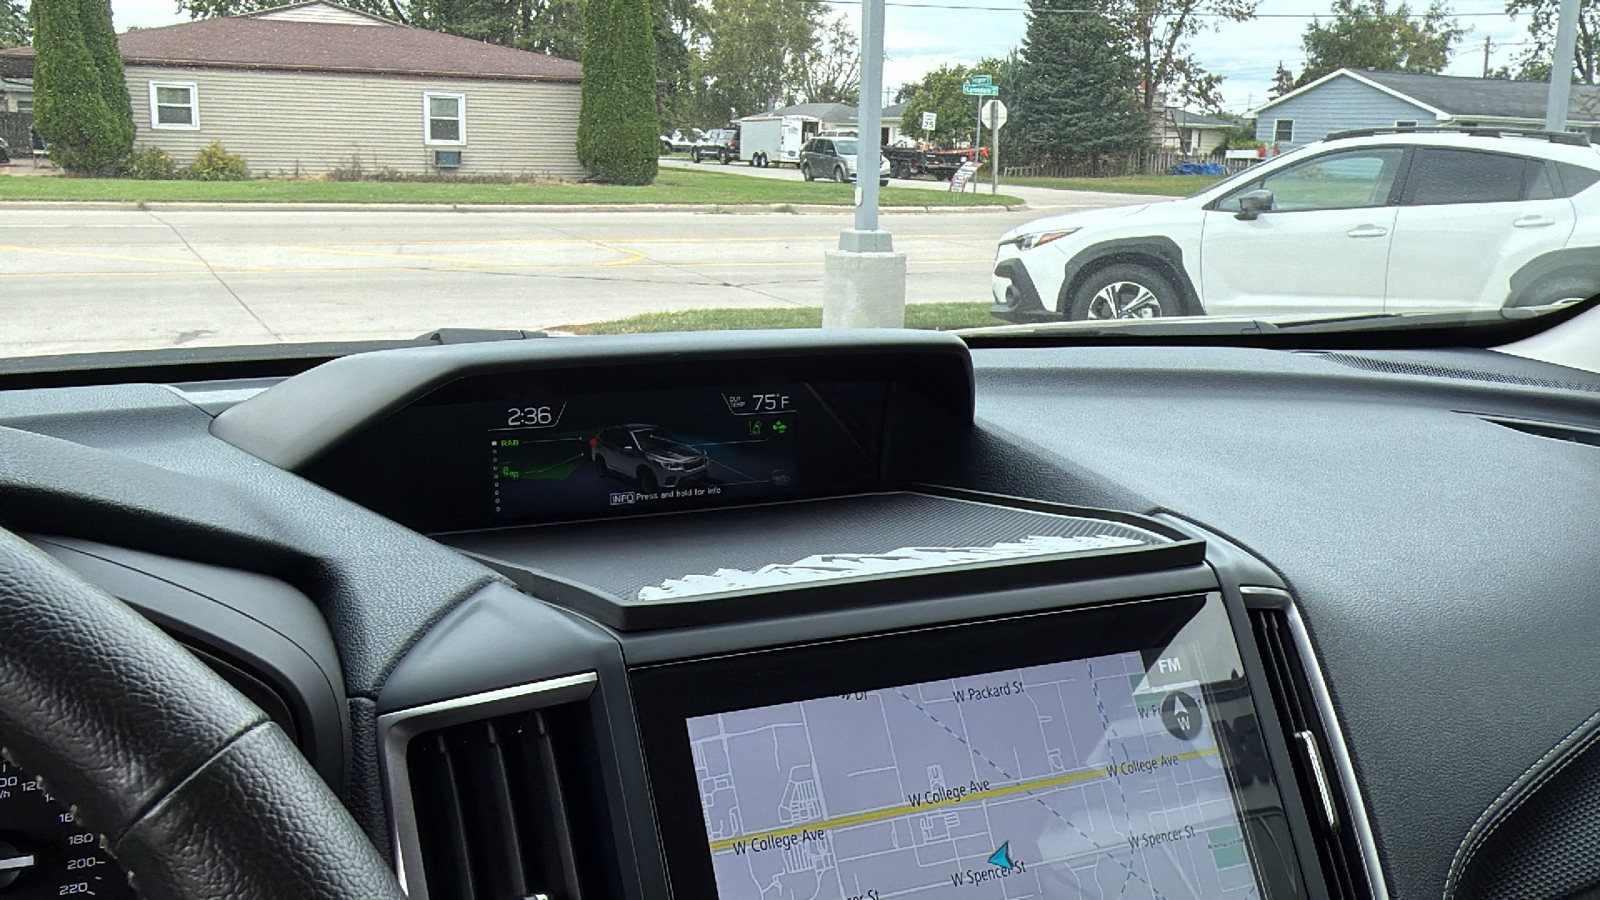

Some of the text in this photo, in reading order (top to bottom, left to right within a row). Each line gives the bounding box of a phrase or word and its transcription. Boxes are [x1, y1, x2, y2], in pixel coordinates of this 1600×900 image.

[508, 406, 552, 425] 2:36
[501, 439, 519, 447] RAB
[612, 494, 634, 503] INFO
[636, 493, 659, 501] Press
[661, 490, 674, 499] and
[676, 489, 693, 498] hold
[694, 488, 705, 496] for
[1158, 657, 1182, 674] FM
[953, 681, 1025, 703] W Packard St
[1138, 707, 1149, 719] W
[1177, 716, 1191, 731] W
[1106, 755, 1179, 778] W College Ave
[908, 780, 991, 808] W College Ave
[59, 812, 74, 822] 16
[68, 833, 94, 845] 180
[732, 828, 825, 856] W College Ave
[1127, 825, 1196, 849] W Spencer St
[67, 857, 96, 870] 200
[950, 860, 1027, 887] W Spencer St
[59, 882, 88, 896] 220
